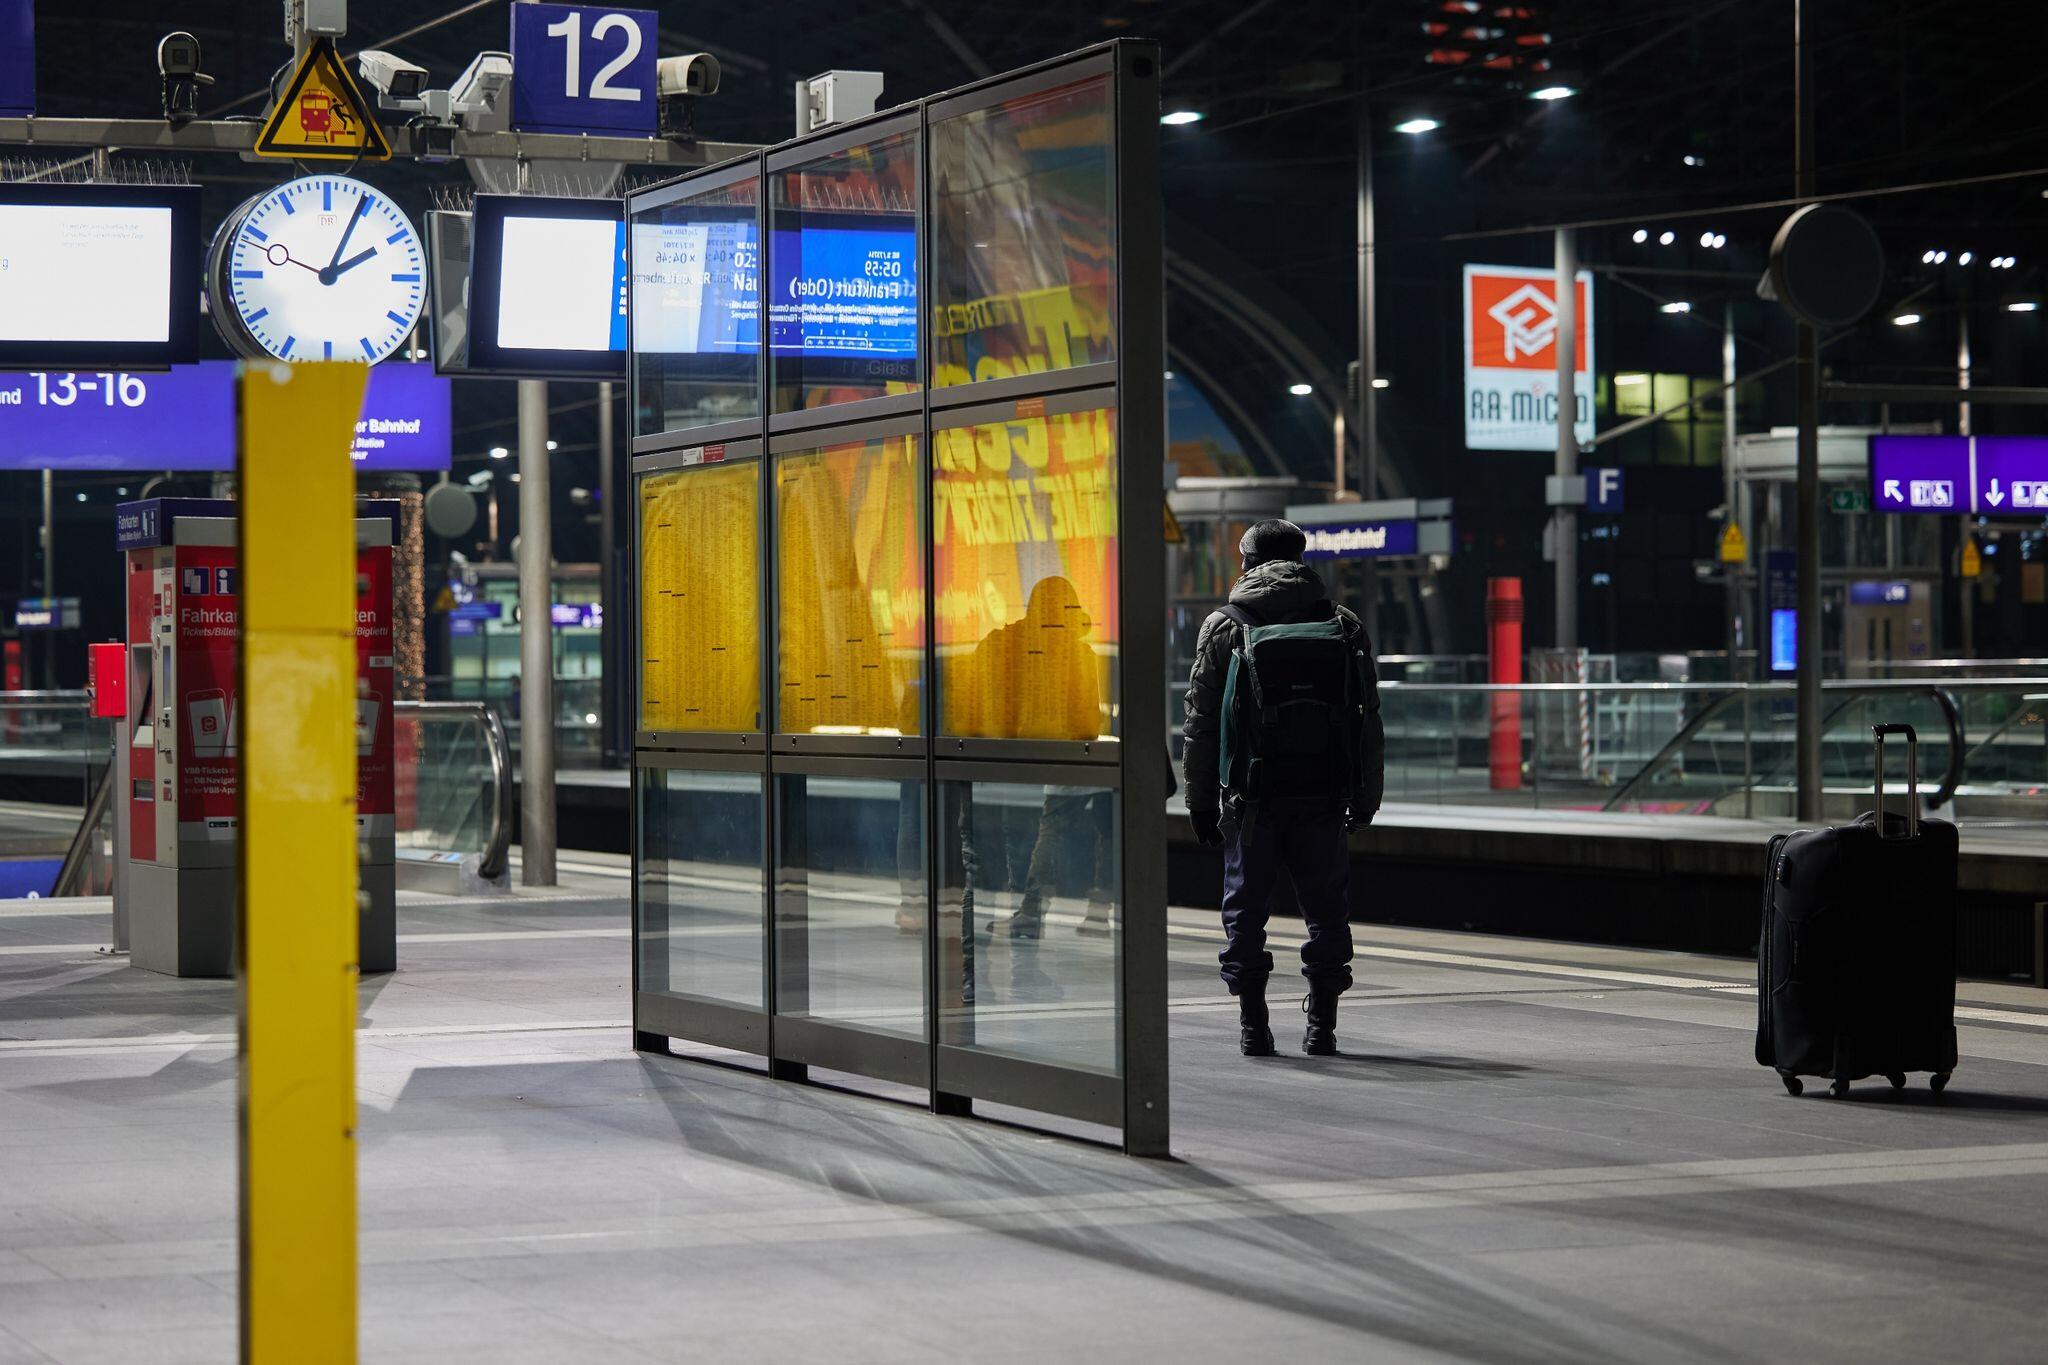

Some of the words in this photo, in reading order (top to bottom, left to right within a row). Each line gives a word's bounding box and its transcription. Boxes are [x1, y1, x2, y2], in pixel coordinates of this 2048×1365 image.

[547, 11, 642, 101] 12
[0, 388, 22, 405] nd
[29, 372, 147, 407] 13-16
[356, 437, 385, 449] Station
[369, 418, 421, 434] Bahnhof
[1599, 468, 1619, 504] F
